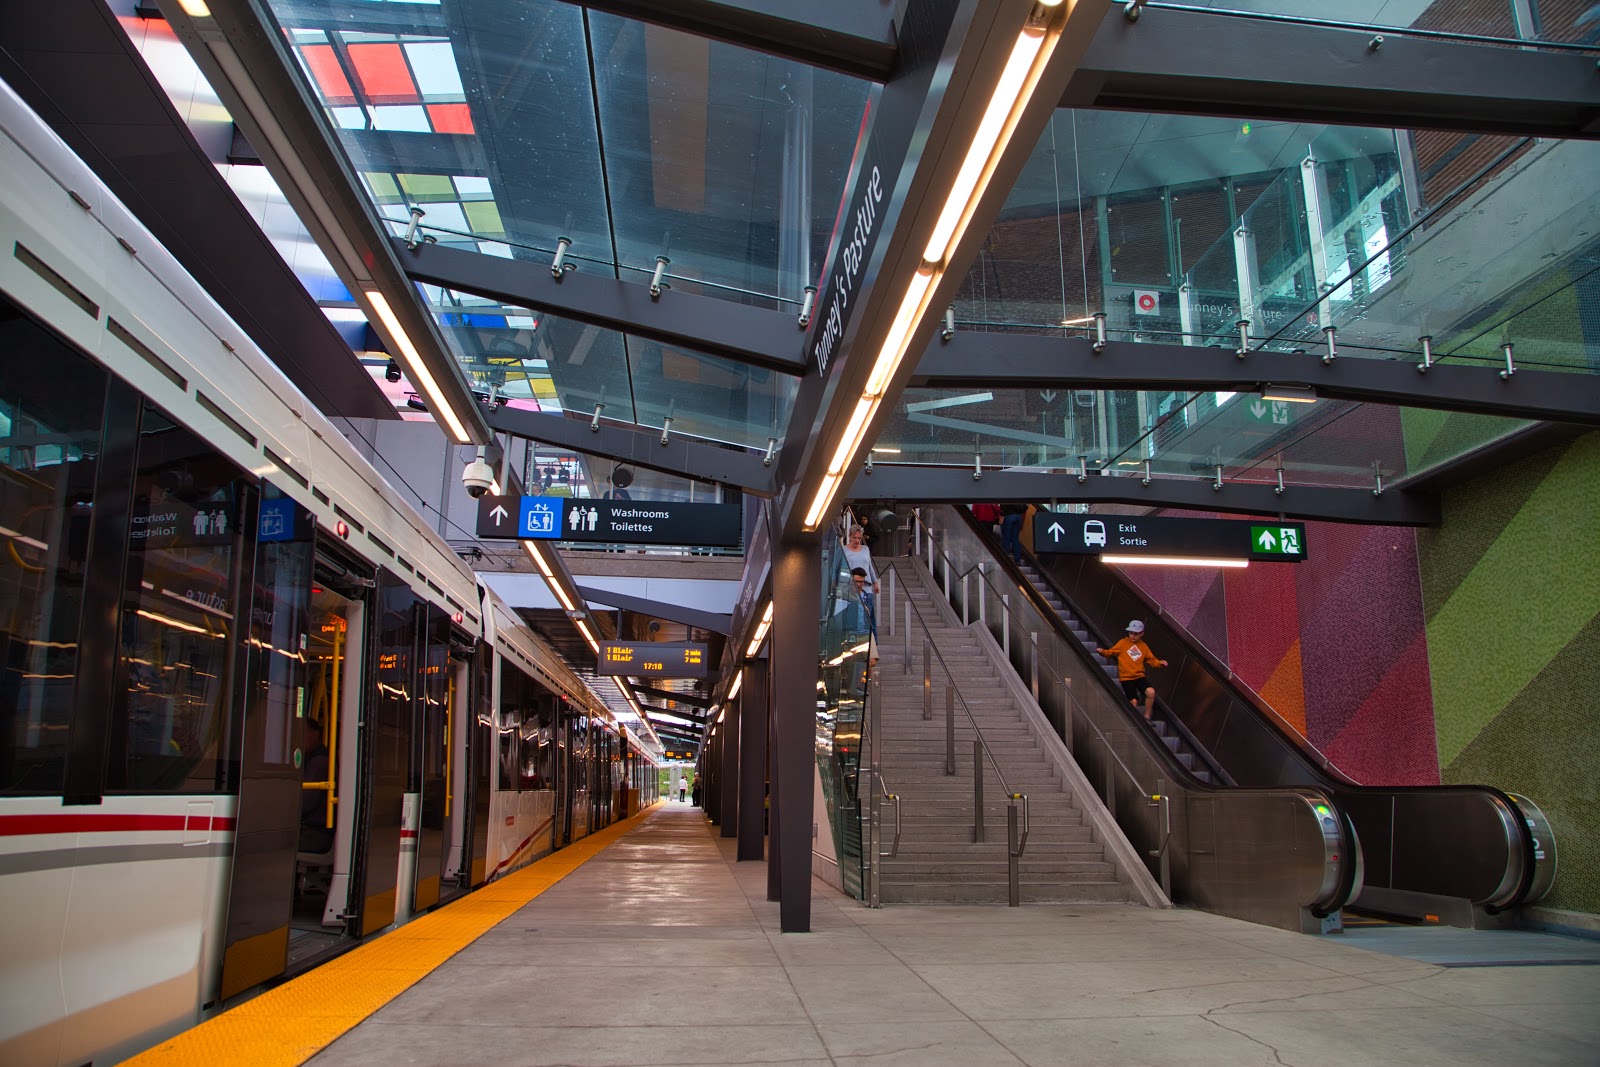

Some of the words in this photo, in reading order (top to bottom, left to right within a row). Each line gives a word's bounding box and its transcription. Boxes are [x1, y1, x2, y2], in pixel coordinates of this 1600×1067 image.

[814, 275, 848, 378] Tunney's
[843, 165, 883, 290] Pasture
[1189, 303, 1233, 317] unney's
[610, 508, 670, 519] Washrooms
[610, 521, 653, 532] Toilettes
[1118, 523, 1137, 533] Exit
[1119, 536, 1148, 546] Sortie
[613, 654, 634, 662] Blair
[643, 662, 663, 670] 17:10
